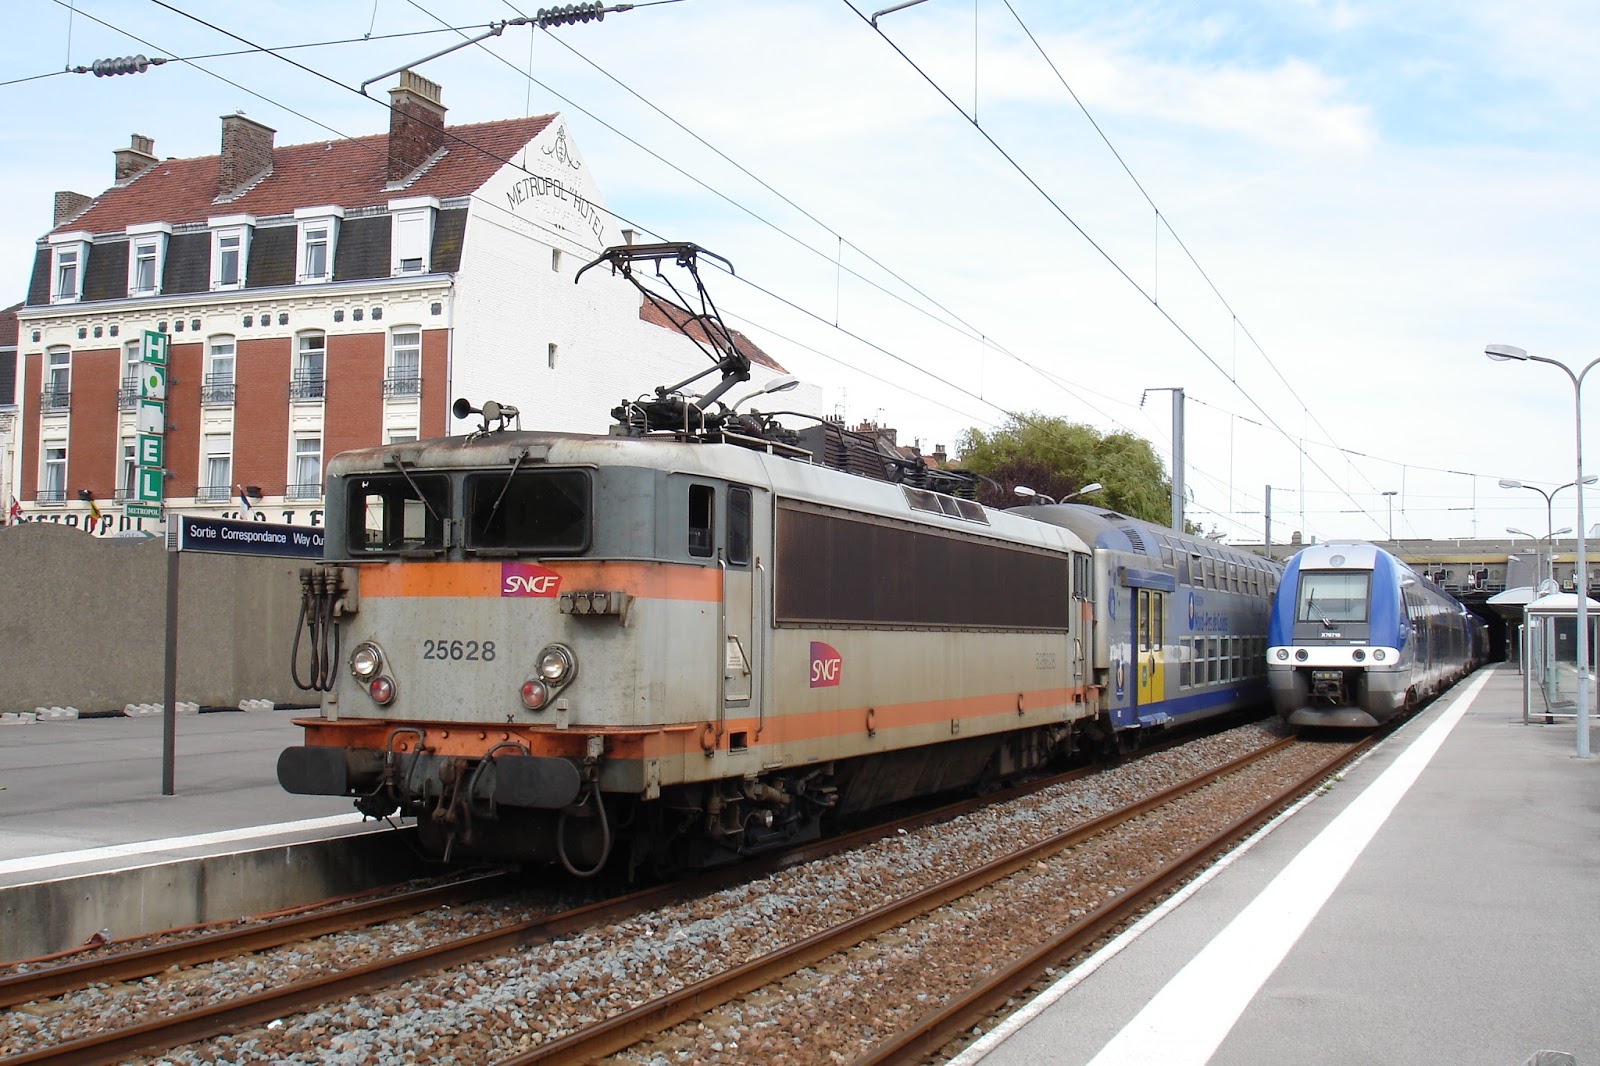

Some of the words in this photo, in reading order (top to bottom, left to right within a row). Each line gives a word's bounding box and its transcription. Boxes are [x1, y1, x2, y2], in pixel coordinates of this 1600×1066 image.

[506, 177, 568, 211] METROPOL
[573, 191, 604, 247] HOTEL
[127, 506, 160, 516] METROPOL
[190, 524, 217, 539] Sortie
[221, 527, 287, 544] Correspondance
[293, 532, 310, 547] Way
[312, 534, 324, 546] Ou
[503, 575, 559, 593] SNCF
[423, 639, 496, 662] 25628
[811, 658, 841, 682] SNCF
